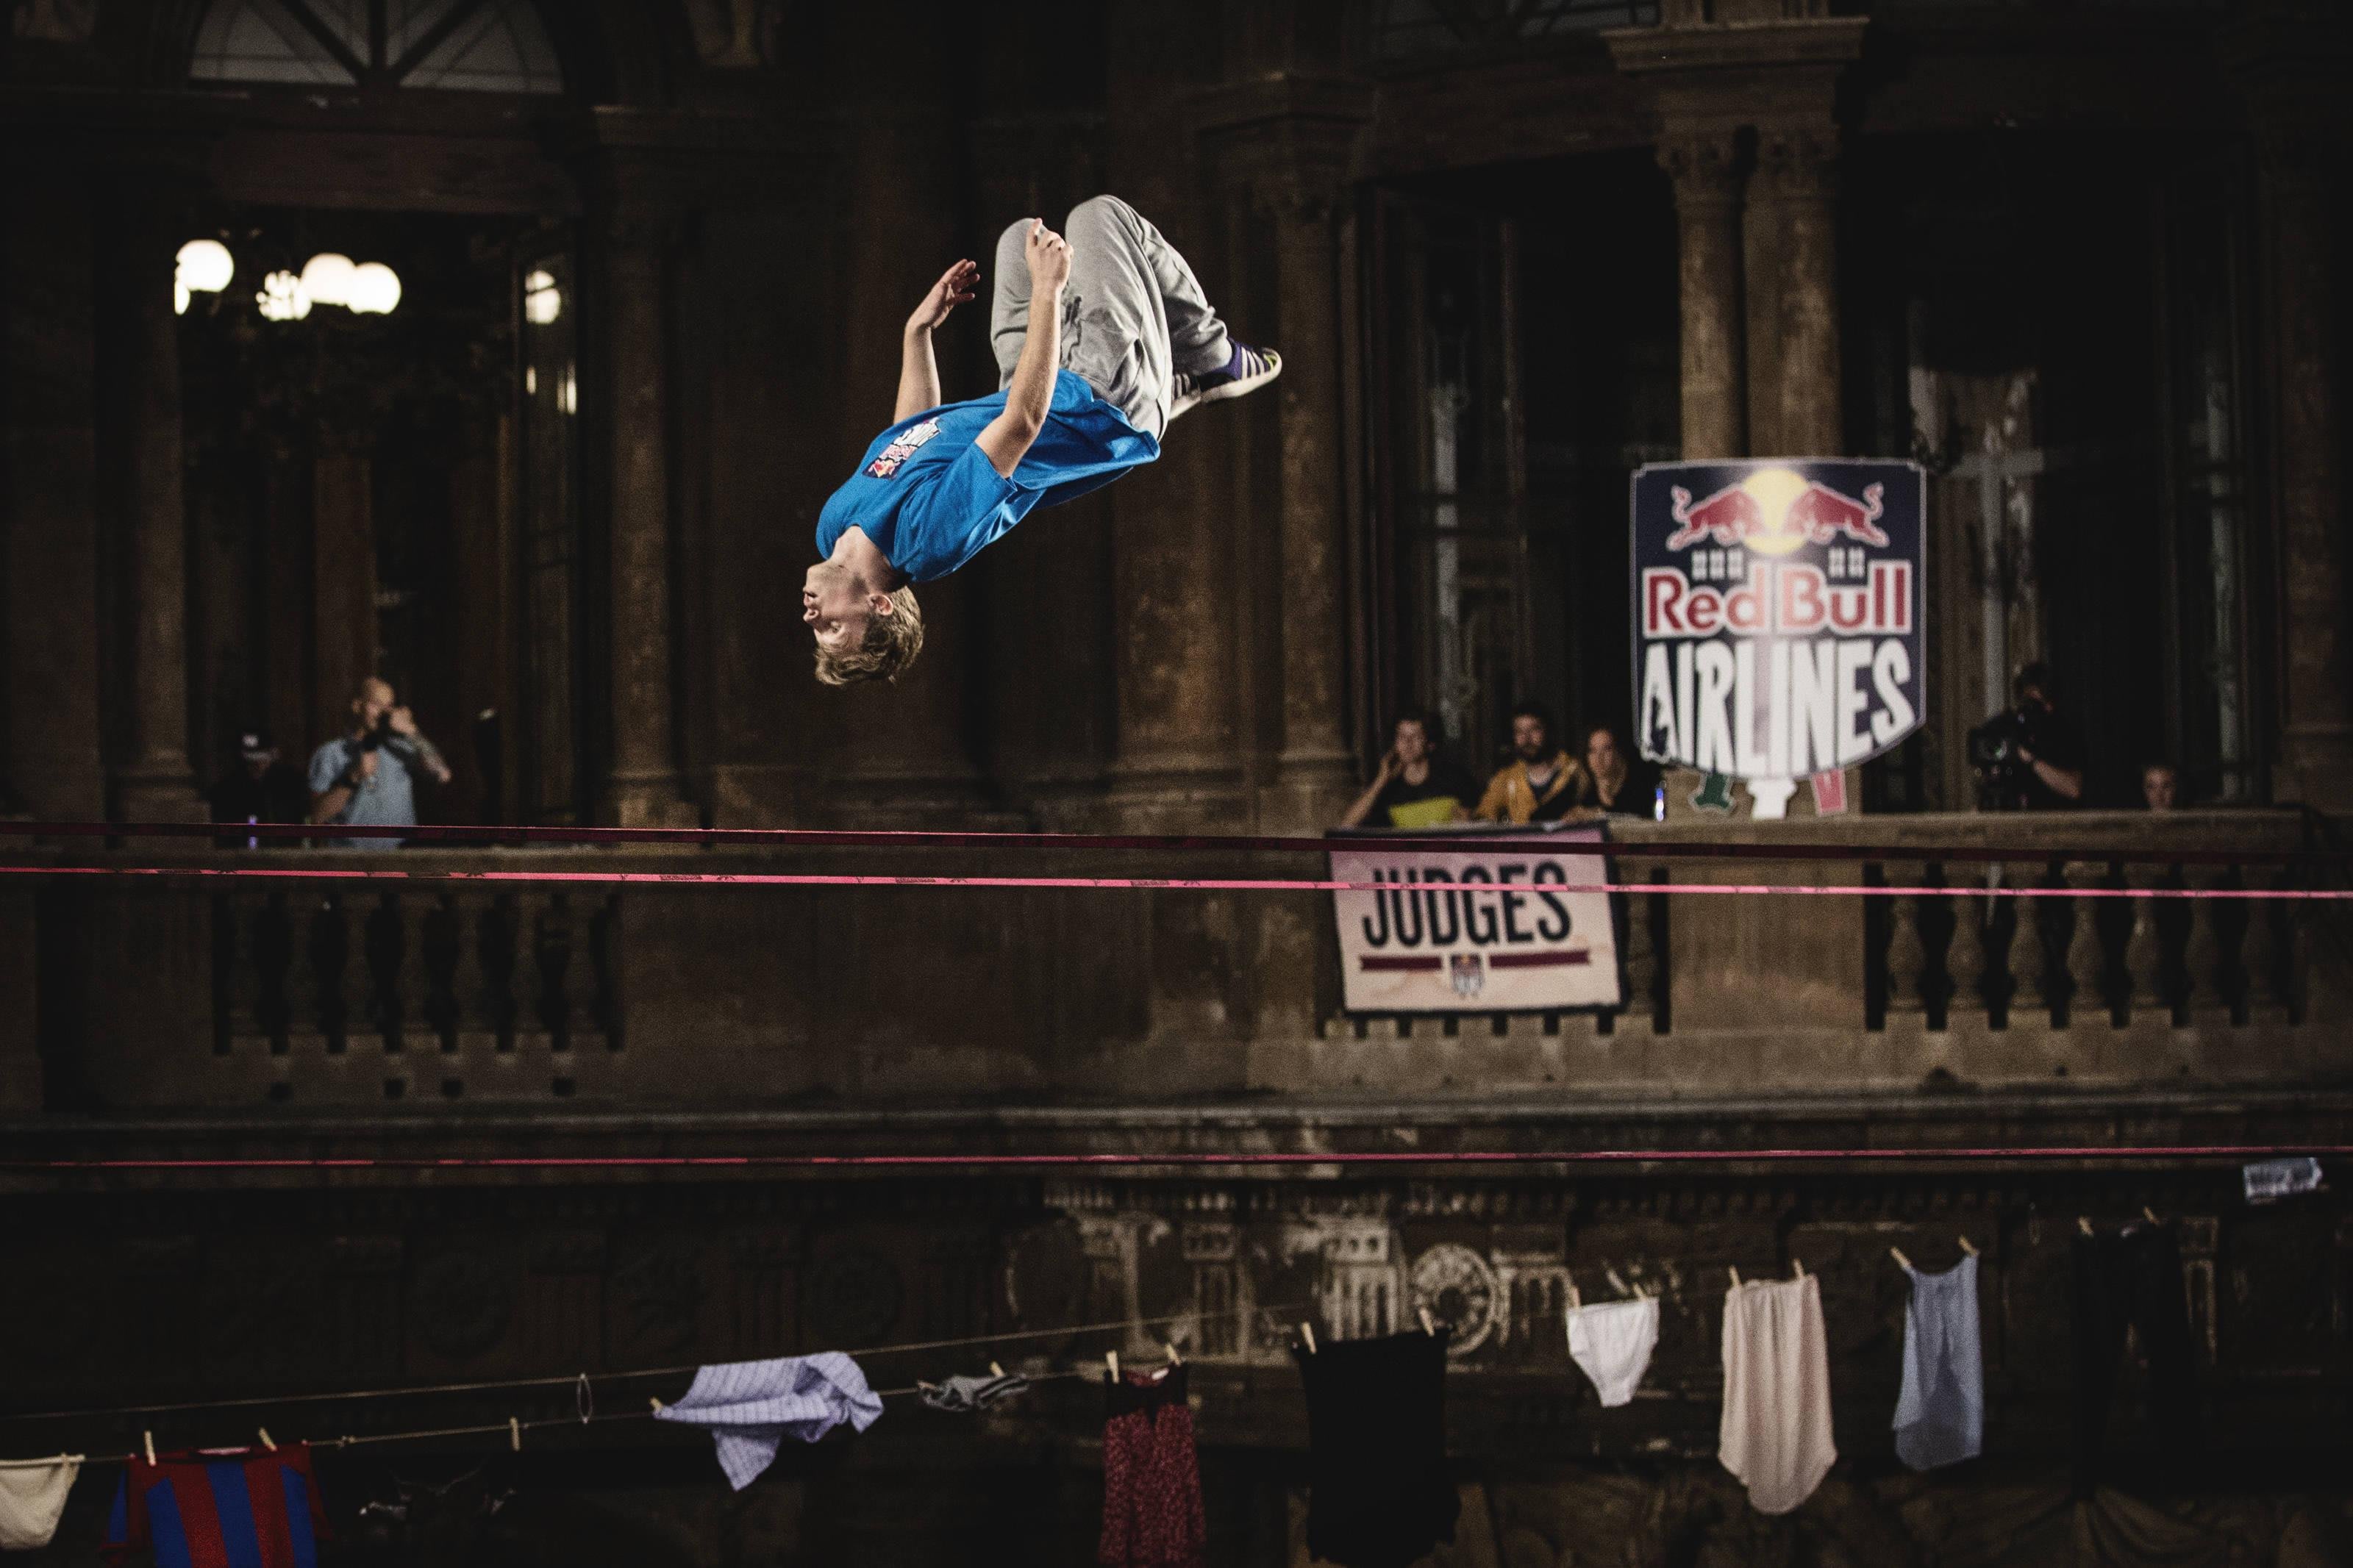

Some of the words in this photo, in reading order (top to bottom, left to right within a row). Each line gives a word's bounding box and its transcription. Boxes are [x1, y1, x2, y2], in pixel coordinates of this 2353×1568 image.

[1647, 565, 1767, 631] Red
[1782, 565, 1907, 630] Bull
[1640, 638, 1916, 777] AIRLINES
[1362, 861, 1571, 948] JUDGES
